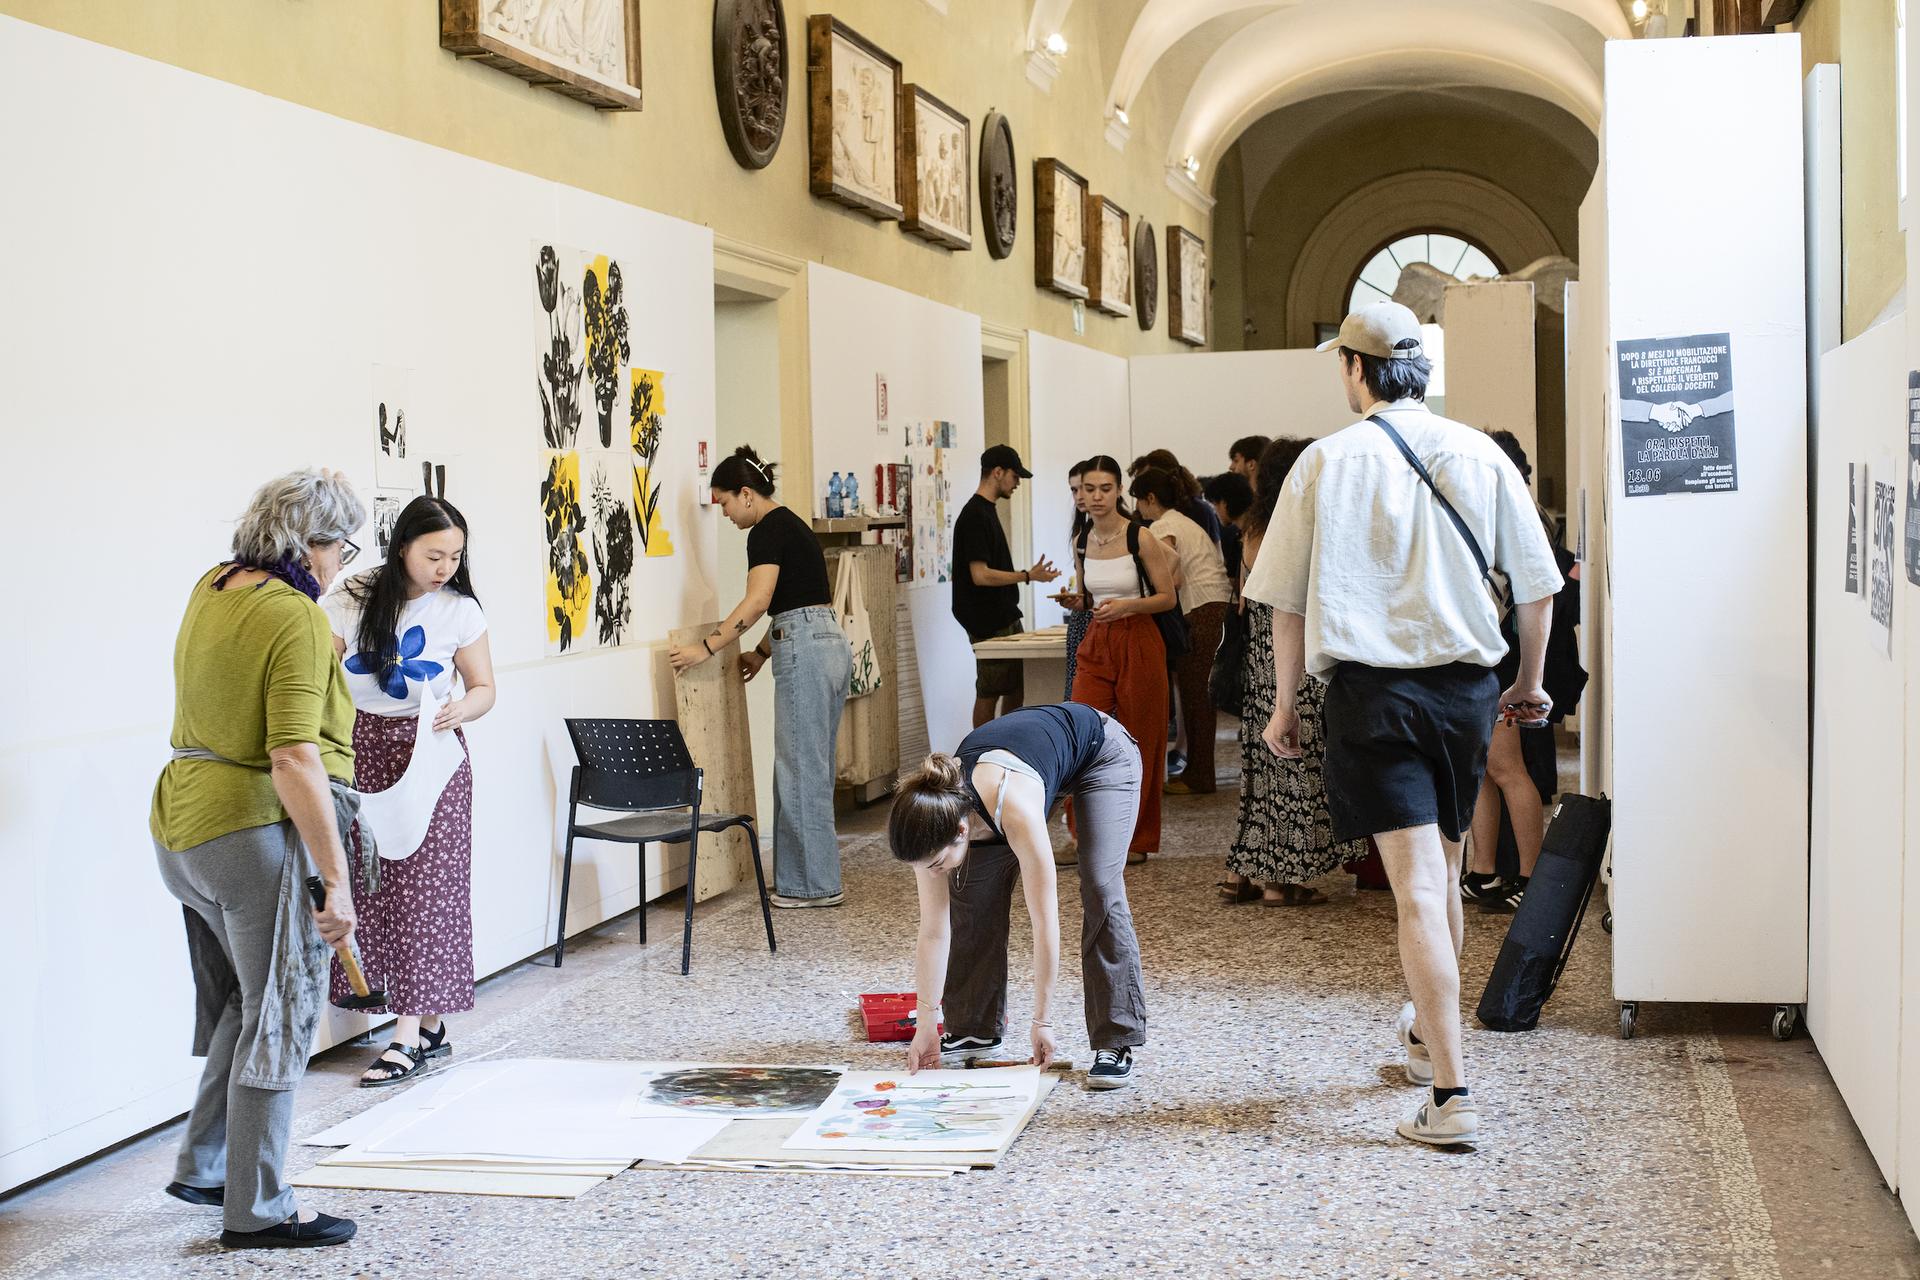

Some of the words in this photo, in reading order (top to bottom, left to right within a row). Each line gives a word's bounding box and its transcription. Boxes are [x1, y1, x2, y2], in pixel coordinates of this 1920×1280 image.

[1621, 352, 1639, 361] DOPO
[1648, 350, 1665, 359] MESI
[1676, 346, 1727, 357] MOBILITAZIONE
[1631, 360, 1639, 369] LA
[1641, 358, 1679, 368] DIRETTRICE
[1680, 355, 1718, 365] FRANCUCCI
[1657, 366, 1662, 375] È
[1663, 365, 1701, 375] IMPEGNATA
[1632, 378, 1637, 386] A
[1638, 376, 1676, 385] RISPETTARE
[1678, 374, 1685, 382] IL
[1686, 372, 1719, 382] VERDETTO
[1636, 386, 1649, 394] DEL
[1651, 383, 1683, 393] COLLEGIO
[1684, 381, 1716, 390] DOCENTI.
[1646, 438, 1666, 450] ORA
[1668, 435, 1711, 449] RISPETTI
[1638, 451, 1650, 463] LA
[1652, 448, 1688, 462] PAROLA
[1691, 446, 1719, 459] DATA!
[1628, 468, 1661, 484] 13.06
